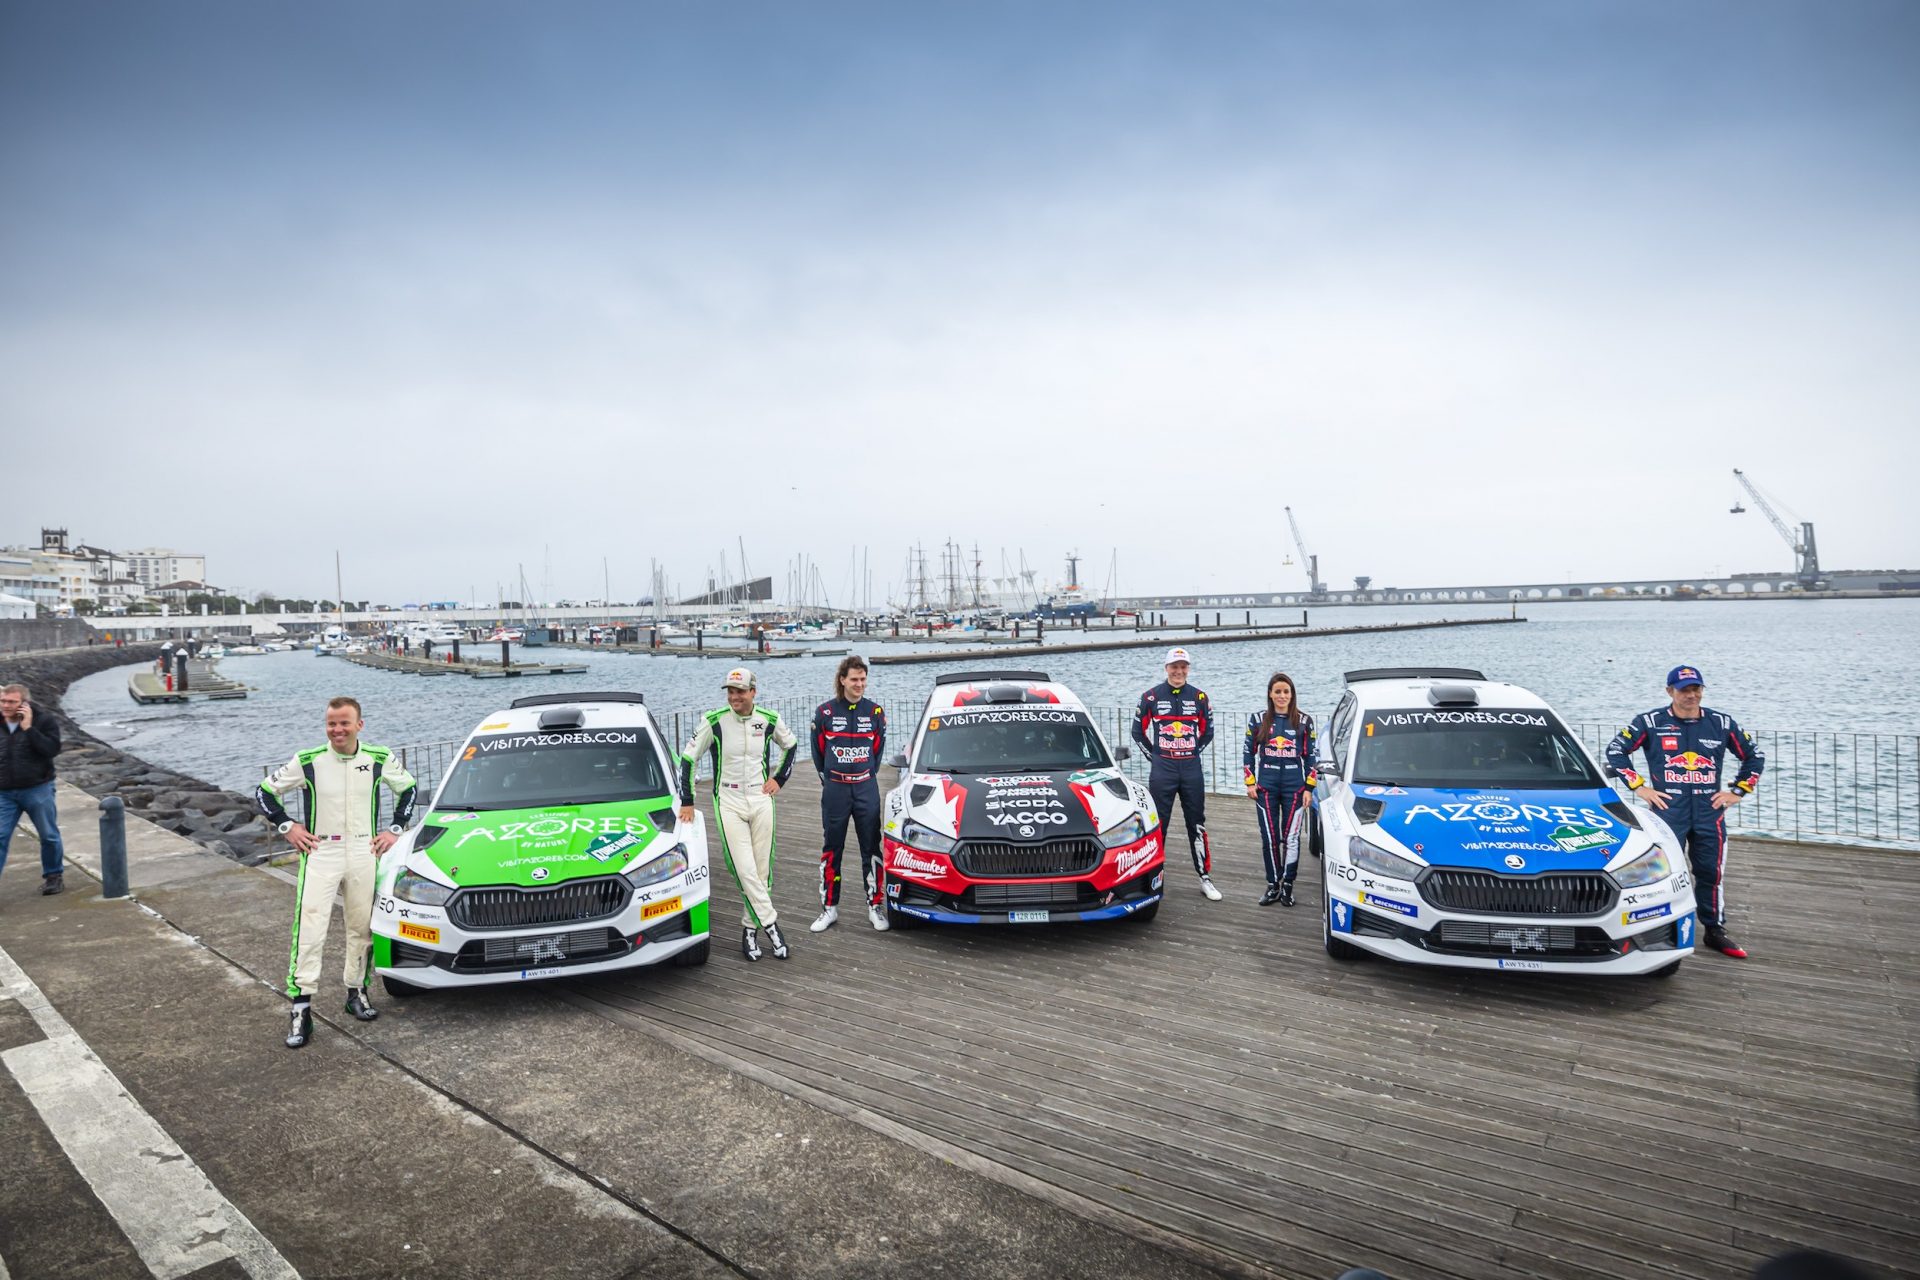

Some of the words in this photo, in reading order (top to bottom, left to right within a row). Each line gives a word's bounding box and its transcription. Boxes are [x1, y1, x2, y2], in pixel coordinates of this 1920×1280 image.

[929, 718, 940, 731] 5
[942, 711, 1077, 727] VISITAZORES.COM
[1377, 711, 1548, 727] VISITAZORES.COM
[1365, 723, 1375, 737] 1
[480, 732, 637, 752] VISITAZORES.COM
[1159, 736, 1178, 748] Red
[1179, 736, 1196, 748] Bull
[463, 747, 477, 760] 2
[1265, 747, 1281, 757] Red
[1282, 748, 1297, 757] Bull
[1664, 769, 1691, 783] Red
[1692, 771, 1716, 784] Bull
[986, 811, 1068, 826] YACCO
[1404, 803, 1613, 829] AZORES
[454, 816, 649, 849] AZORES
[1494, 825, 1531, 833] NATURE
[1566, 825, 1580, 835] 1
[535, 839, 569, 848] NATURE
[1461, 841, 1562, 853] VISITAZORES.COM
[893, 846, 947, 875] Milwaukee
[1114, 837, 1158, 875] Milwaukee
[644, 899, 679, 918] PIRELLI
[1374, 898, 1411, 914] MICHELIN
[402, 924, 437, 941] PIRELLI
